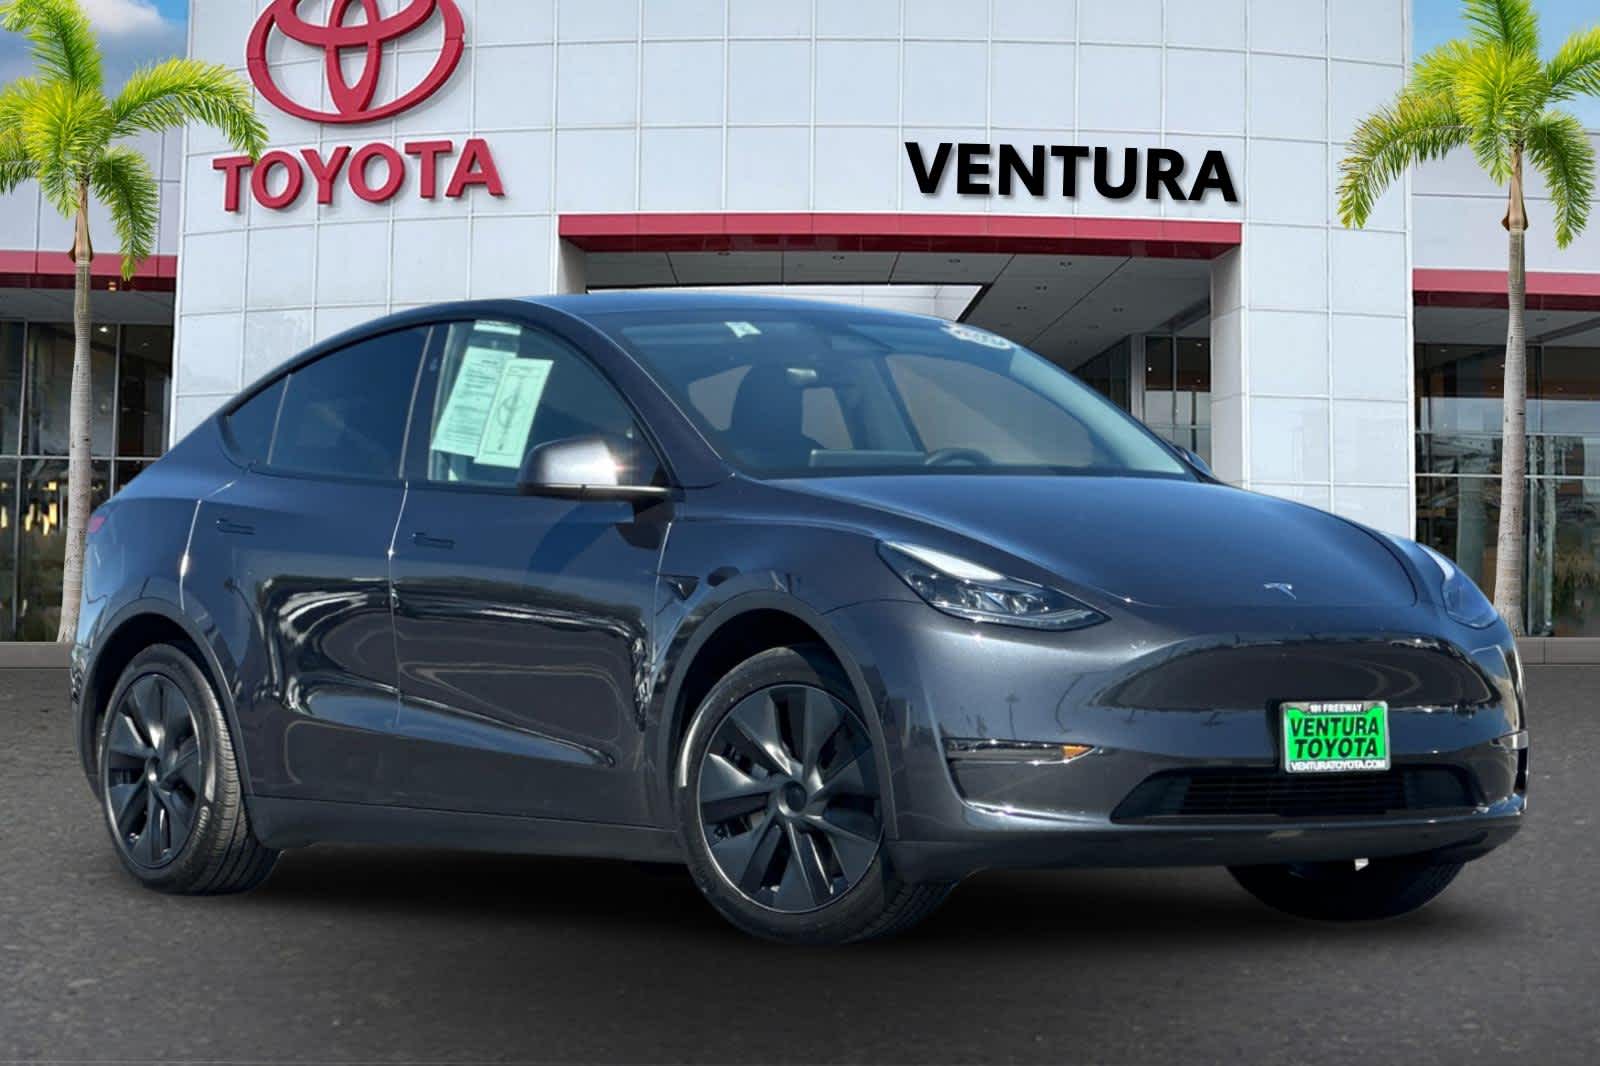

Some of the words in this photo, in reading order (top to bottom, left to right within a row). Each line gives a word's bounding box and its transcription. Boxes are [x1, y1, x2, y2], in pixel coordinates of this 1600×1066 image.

[213, 138, 505, 212] TOYOTA
[904, 141, 1238, 202] VENTURA
[1290, 717, 1379, 736] VENTURA
[1295, 738, 1378, 758] TOYOTA
[1291, 759, 1386, 771] VENTURATOYOTA.COM
